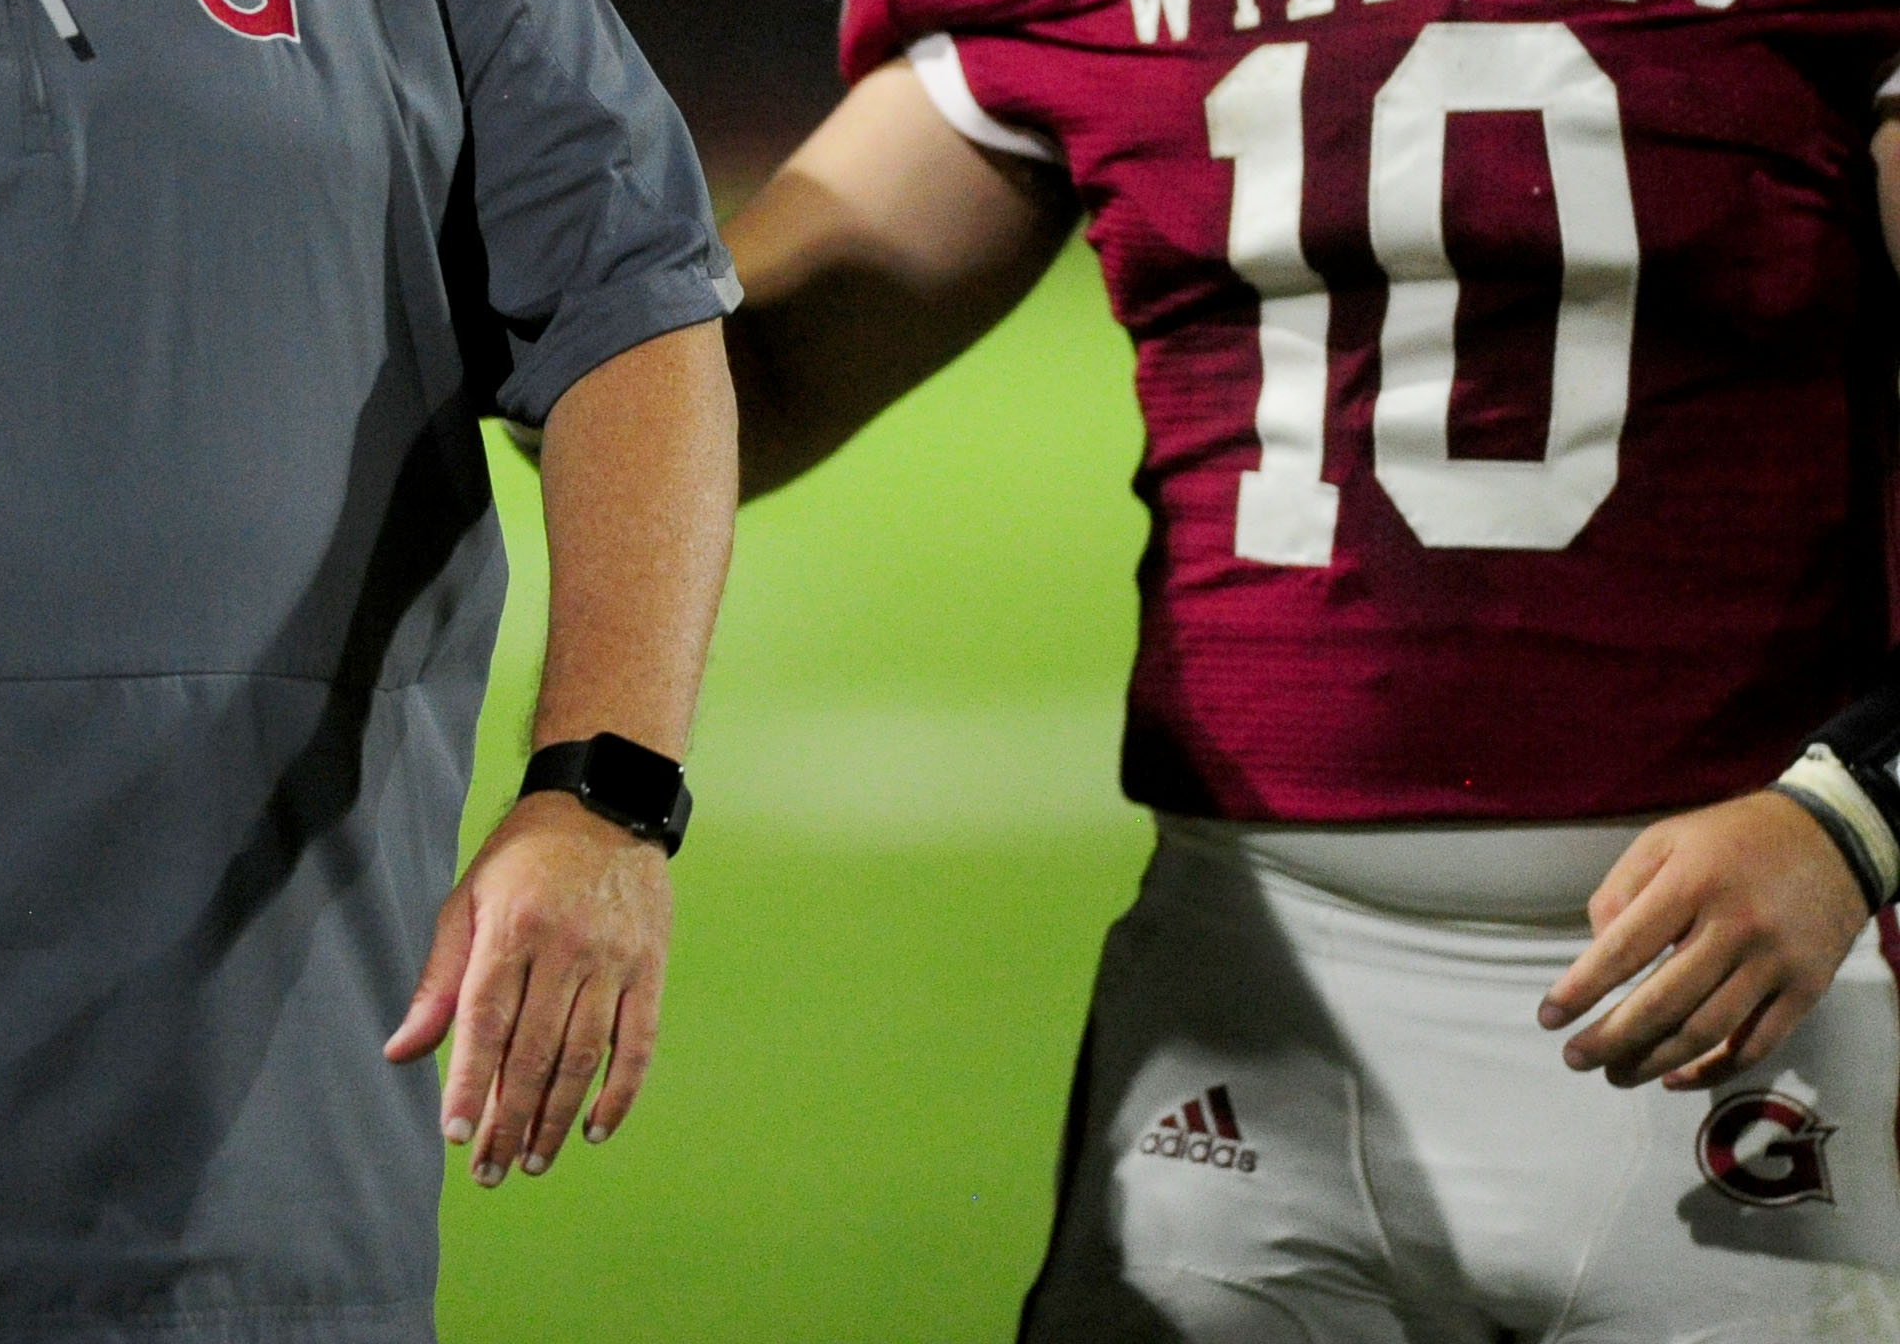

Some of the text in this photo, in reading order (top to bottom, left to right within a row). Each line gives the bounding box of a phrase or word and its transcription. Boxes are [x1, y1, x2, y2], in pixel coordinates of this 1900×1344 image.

[1204, 21, 1640, 566] 10
[1140, 1130, 1257, 1174] adidas
[1696, 1087, 1838, 1209] G
